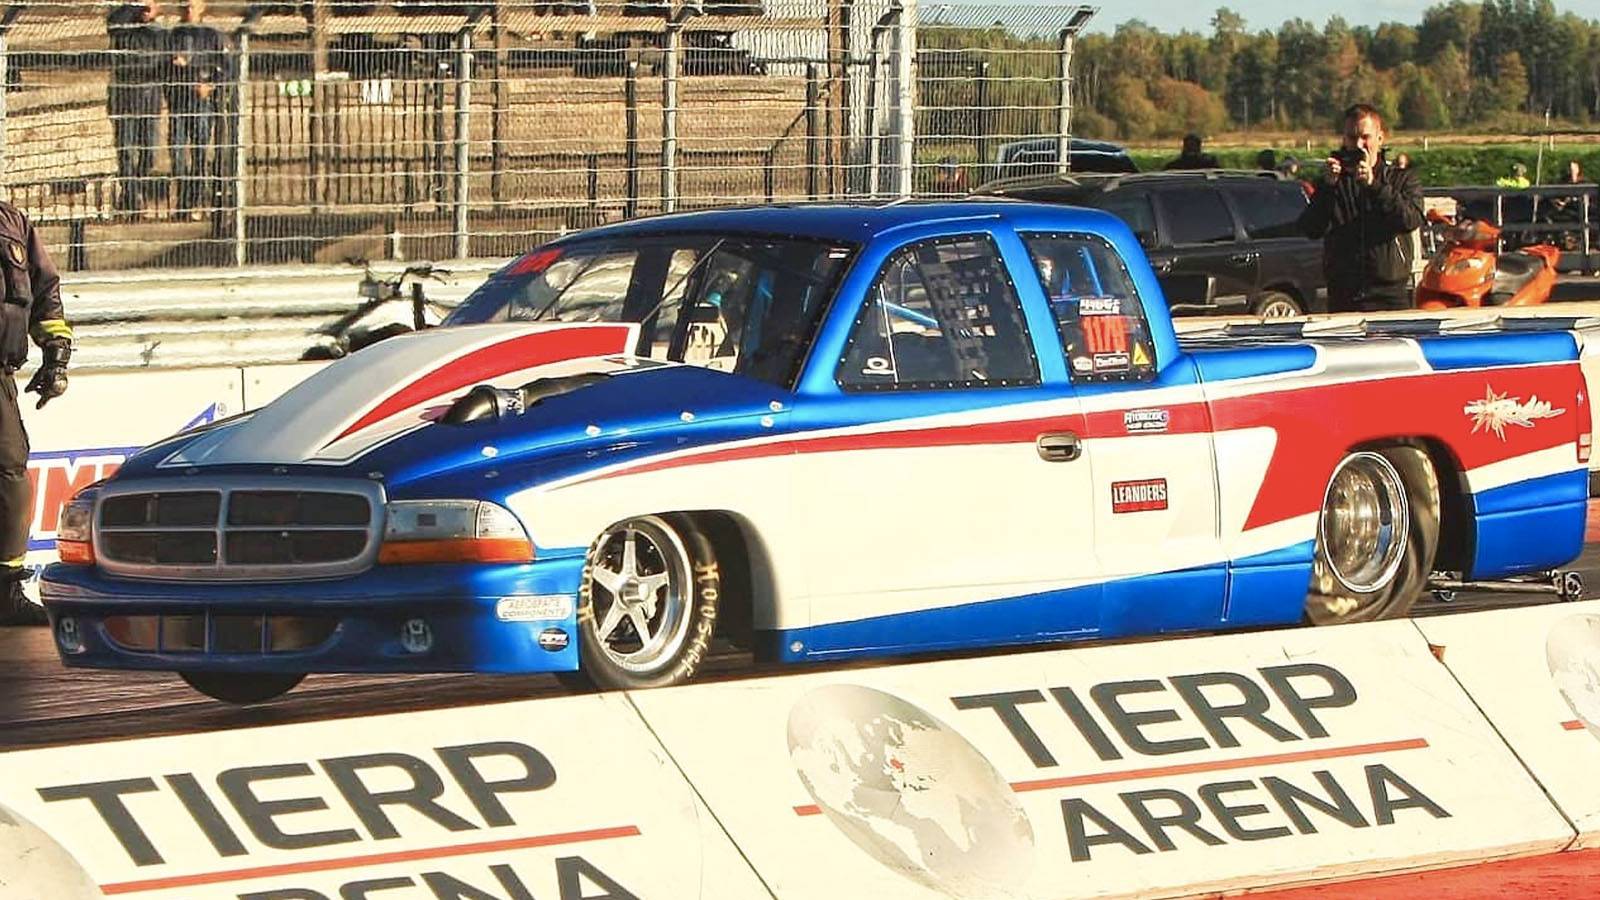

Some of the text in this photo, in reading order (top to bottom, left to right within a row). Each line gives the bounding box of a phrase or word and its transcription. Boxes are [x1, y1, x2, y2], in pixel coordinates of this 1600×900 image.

[1113, 483, 1166, 504] LEANDERS
[950, 663, 1358, 768] TIERP
[35, 740, 557, 866] TIERP
[1059, 763, 1452, 862] ARENA
